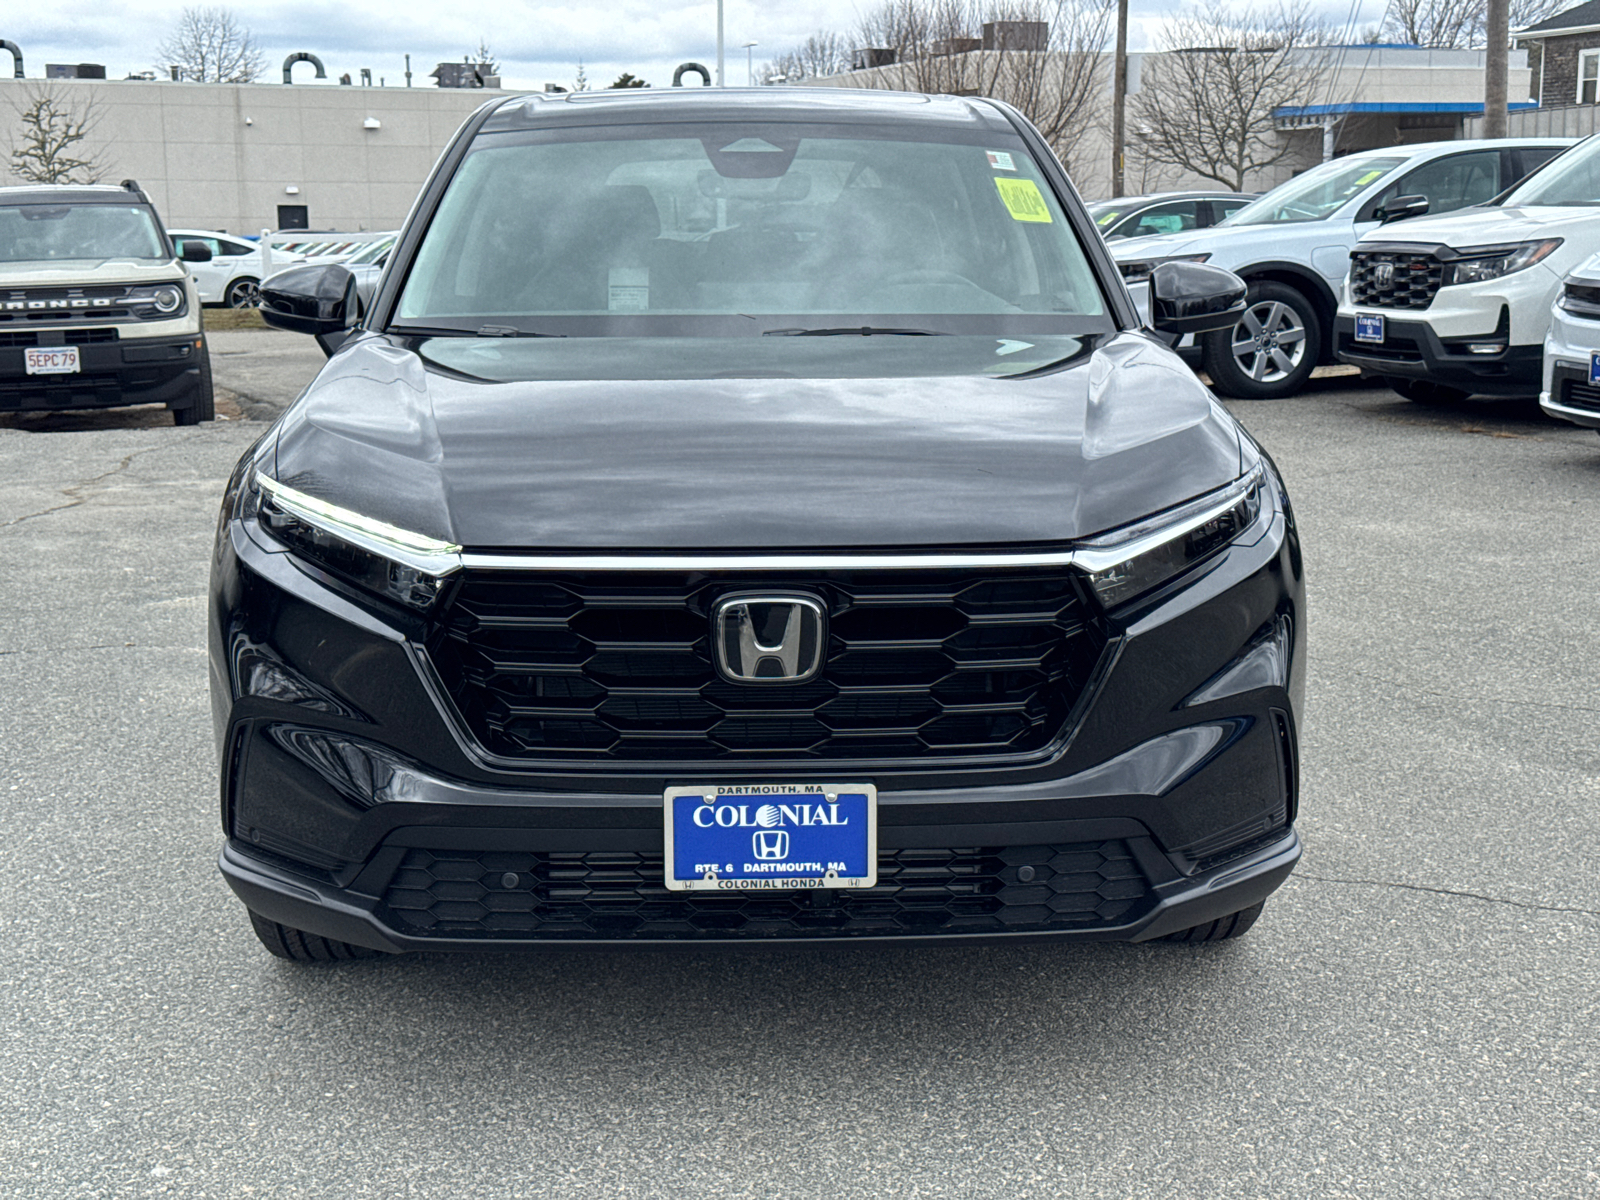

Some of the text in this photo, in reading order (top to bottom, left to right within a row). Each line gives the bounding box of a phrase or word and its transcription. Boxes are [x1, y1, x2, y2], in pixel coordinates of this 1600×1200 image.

[0, 299, 110, 309] RONCO
[28, 353, 76, 367] 5EPC 79
[805, 785, 823, 793] MA
[693, 804, 848, 828] COLONIAL
[695, 862, 847, 873] RTE. 6 DARTMOUTH, MA
[718, 879, 825, 889] COLONIAL HONDA
